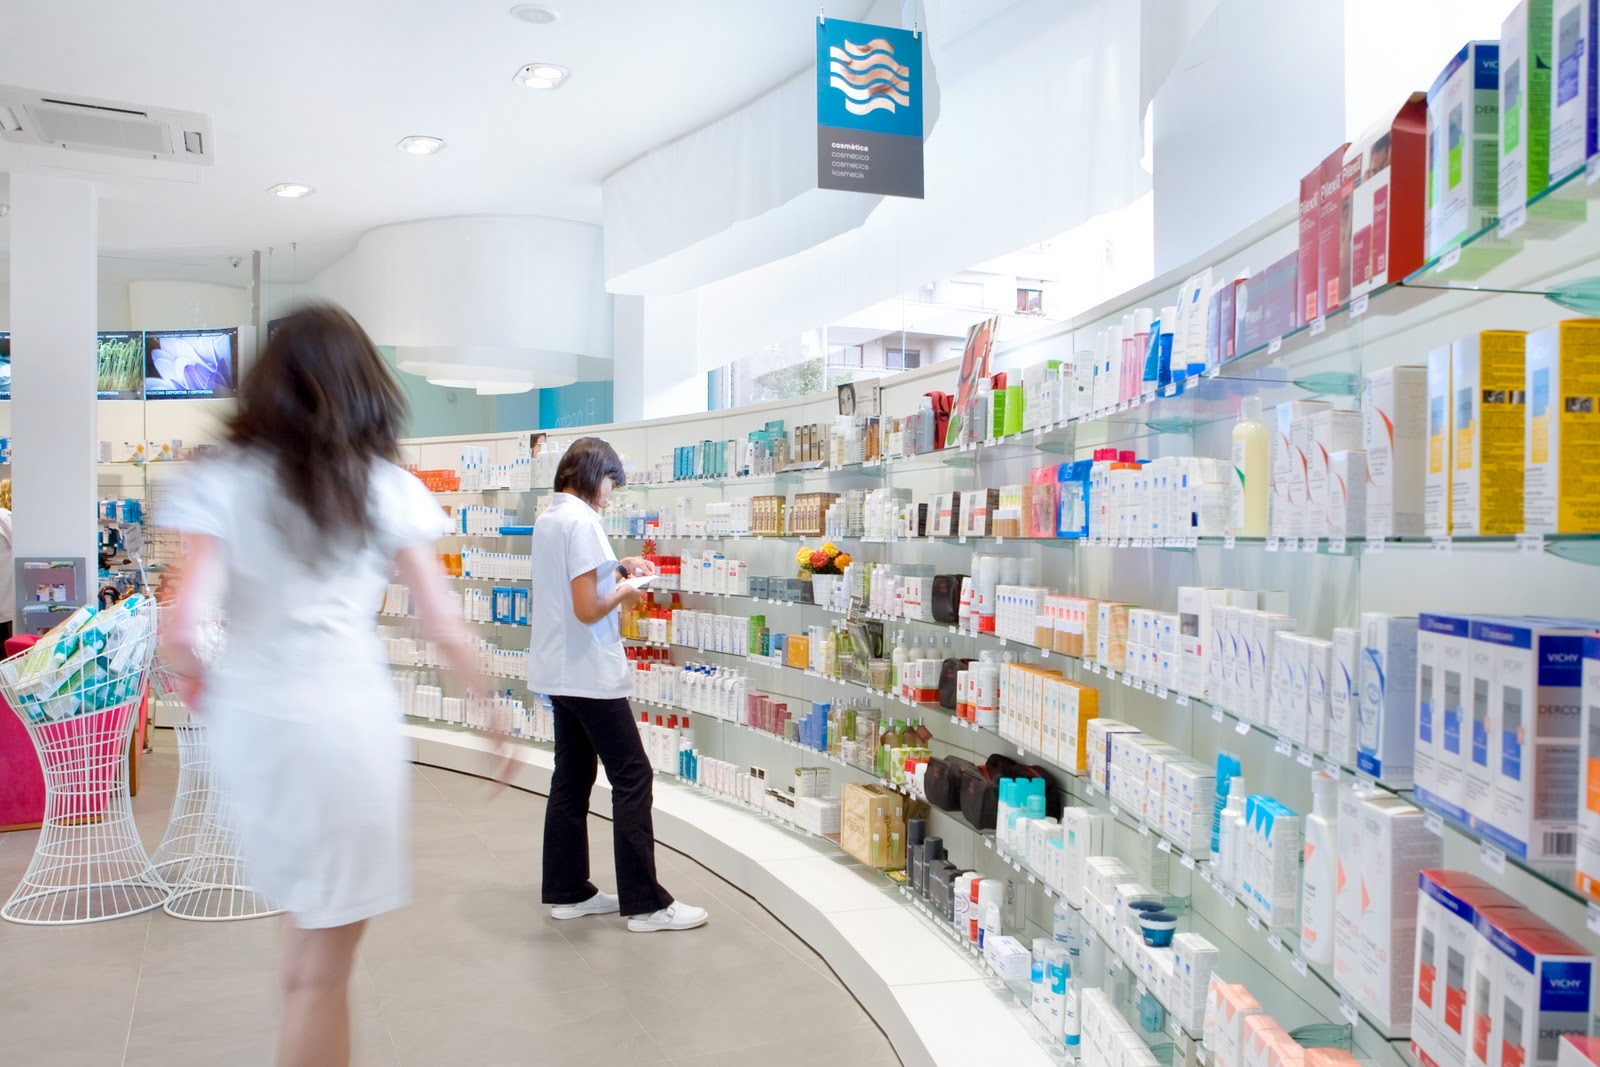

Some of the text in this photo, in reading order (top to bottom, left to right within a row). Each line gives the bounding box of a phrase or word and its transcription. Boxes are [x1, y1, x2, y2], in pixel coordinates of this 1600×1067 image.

[831, 142, 868, 151] cosmètica
[831, 151, 870, 160] cosmética
[831, 160, 870, 170] cosmetics
[831, 169, 864, 178] kosmetik
[1320, 172, 1341, 201] Pilexil
[1547, 653, 1579, 662] VICHY
[1550, 979, 1581, 988] VICHY
